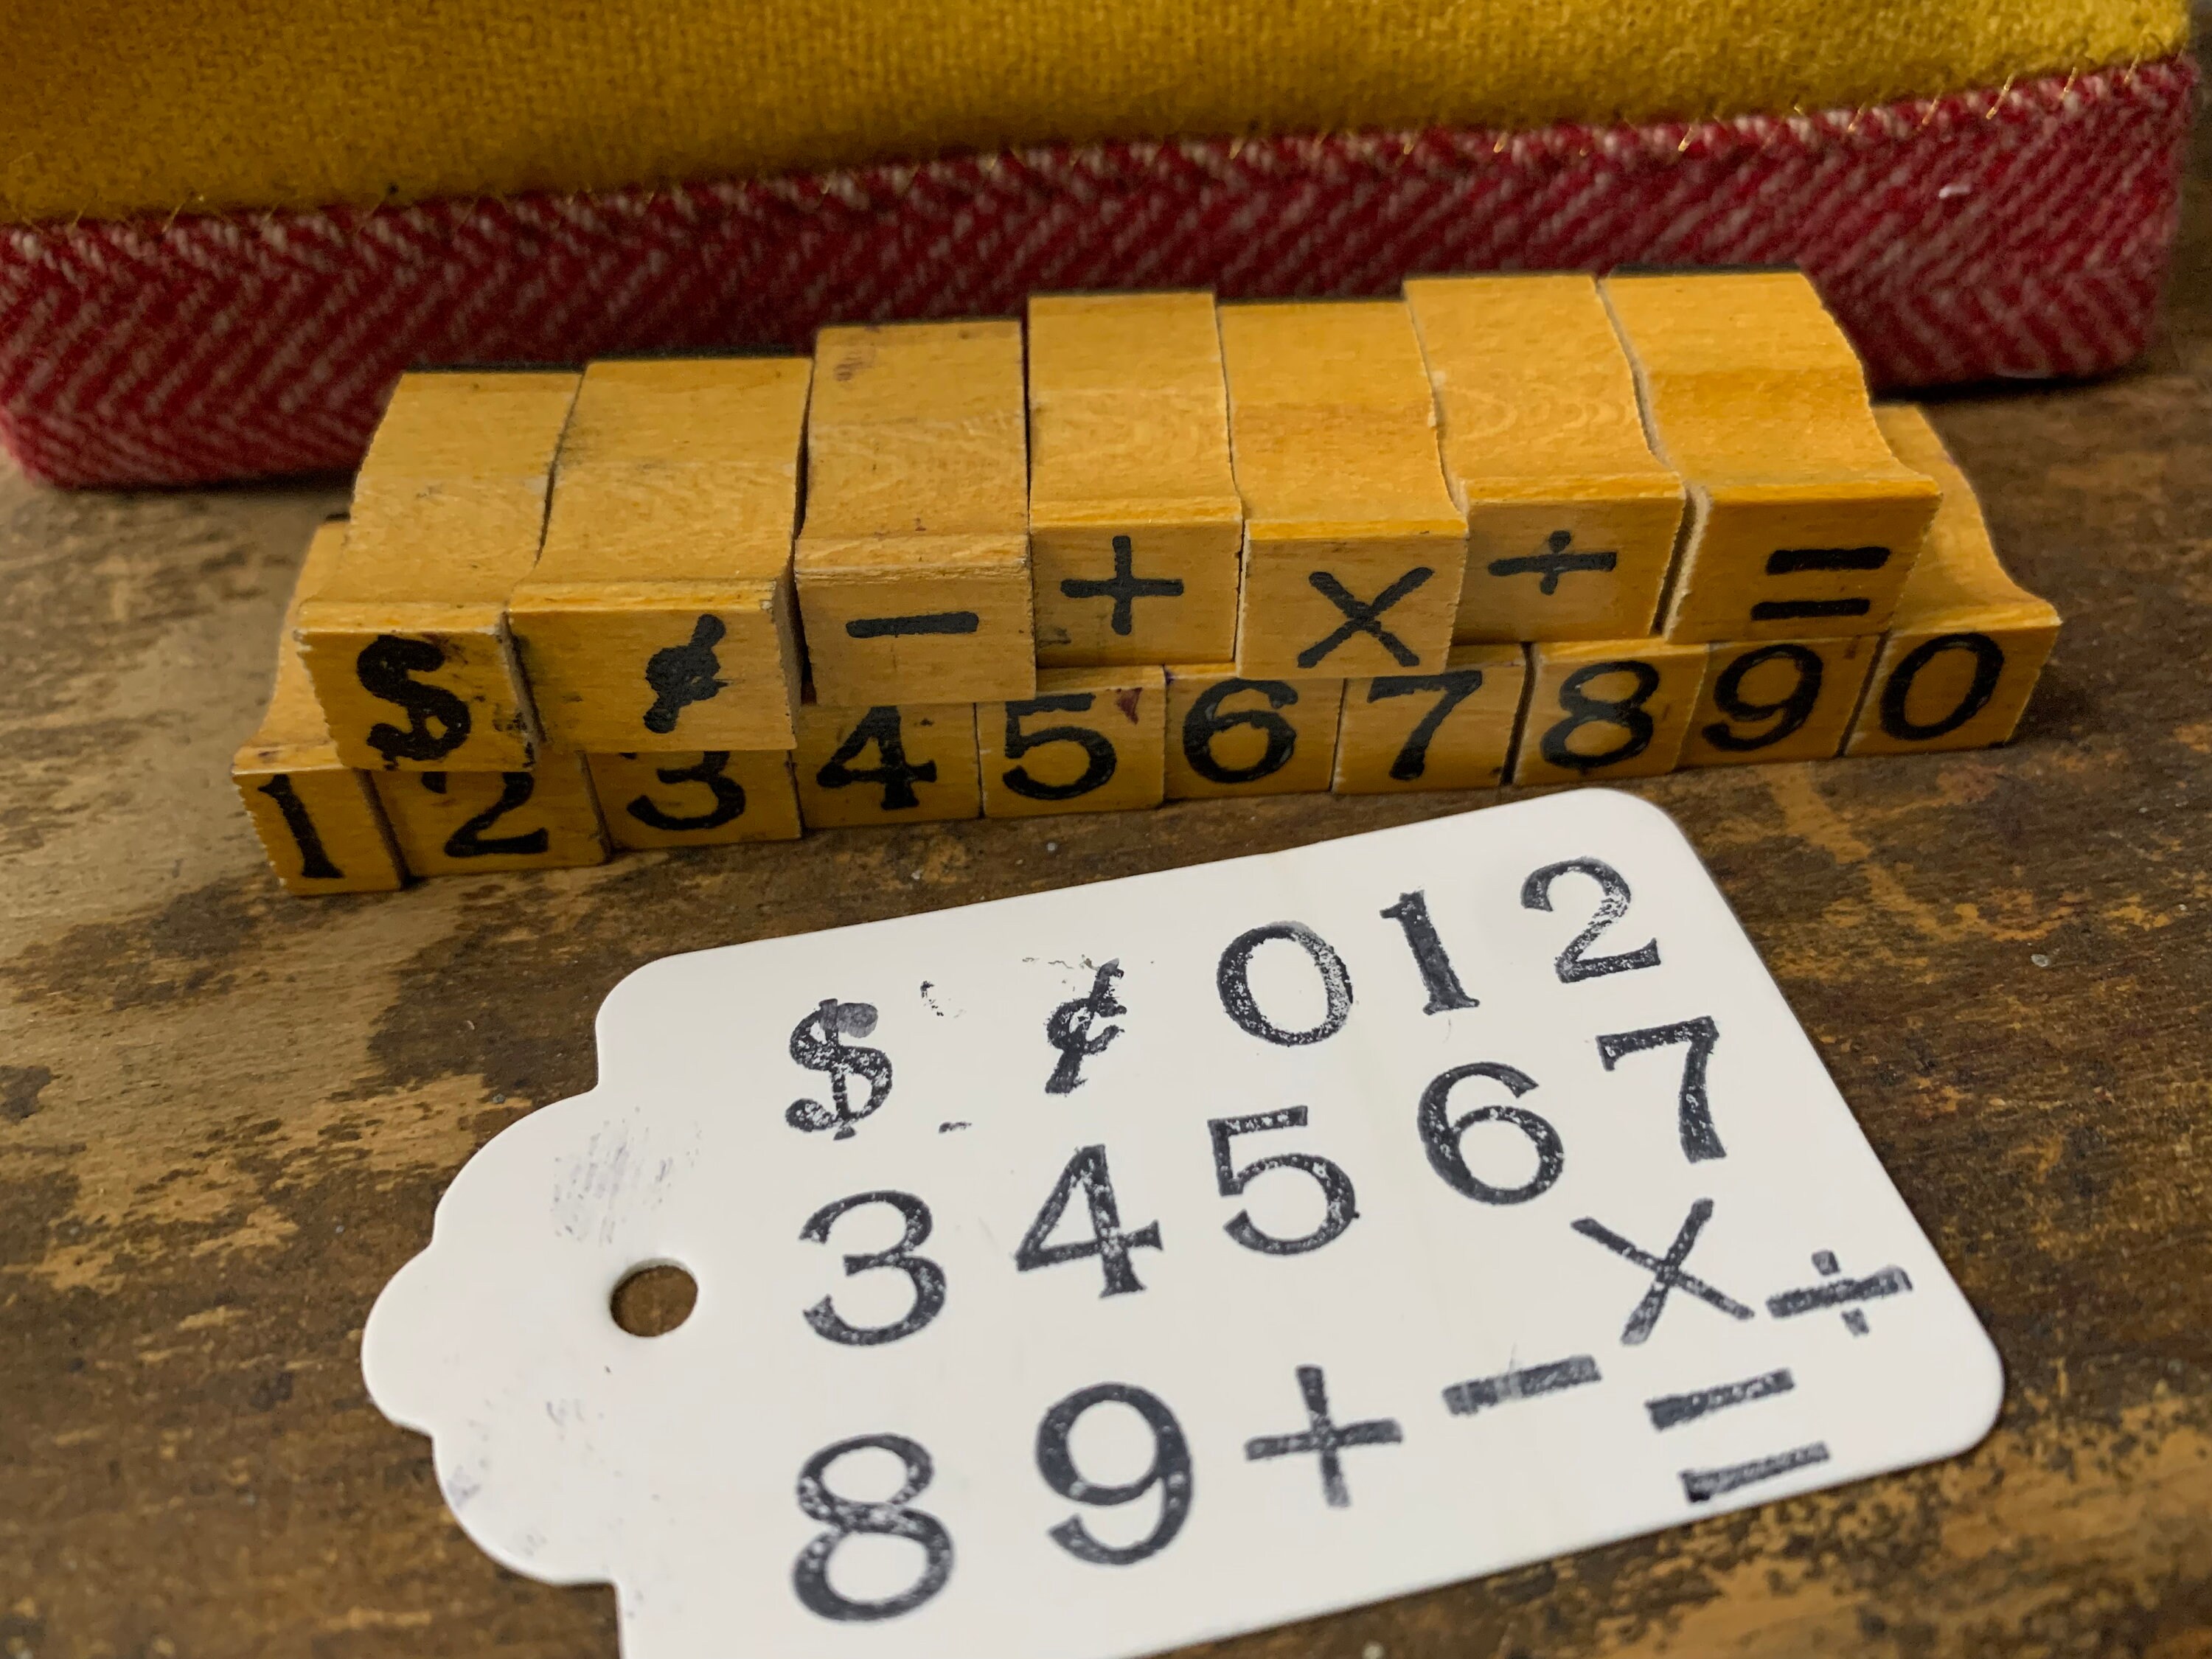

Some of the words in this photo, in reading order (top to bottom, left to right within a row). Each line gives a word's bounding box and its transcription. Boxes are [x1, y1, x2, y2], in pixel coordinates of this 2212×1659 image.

[258, 773, 343, 879] 1
[422, 771, 547, 858] 2
[620, 751, 745, 830] 3
[816, 706, 936, 811] 4
[1004, 694, 1118, 801] 5
[1182, 678, 1298, 785] 6
[1374, 671, 1483, 780] 7
[1540, 661, 1660, 770] 8
[1703, 643, 1823, 751] 9
[1879, 633, 2005, 740] 0
[785, 998, 892, 1140] $
[1216, 920, 1354, 1046] 0
[1380, 888, 1480, 1015] 1
[1520, 857, 1660, 984] 2
[799, 1190, 947, 1346] 3
[1015, 1144, 1164, 1298] 4
[1207, 1105, 1360, 1255] 5
[1416, 1061, 1564, 1206] 6
[1596, 1015, 1727, 1164] 7
[793, 1433, 954, 1623] 8
[1035, 1382, 1193, 1567] 9
